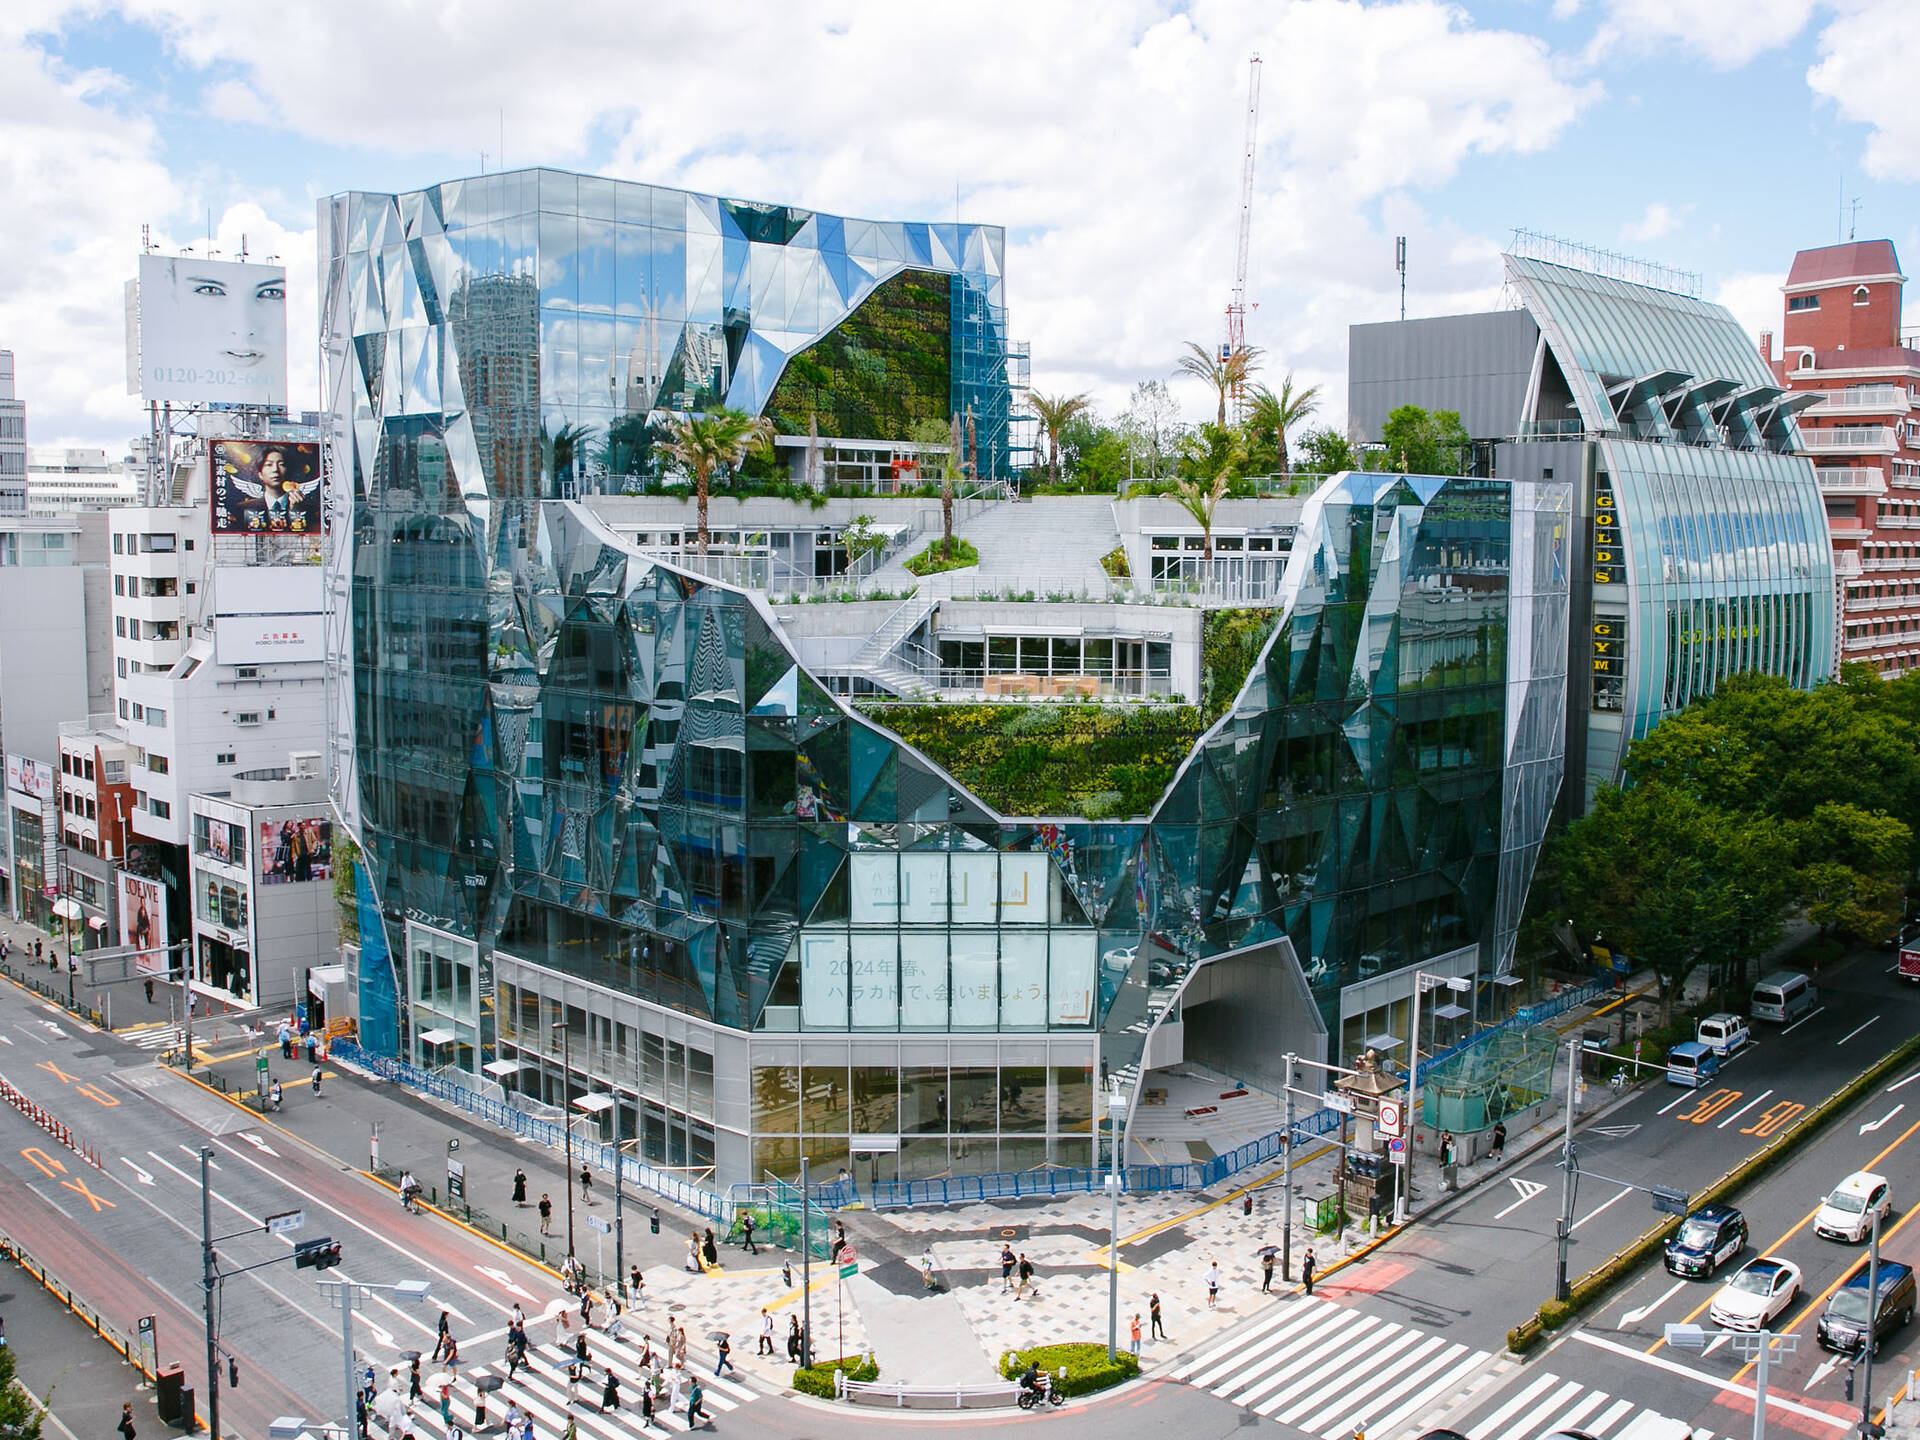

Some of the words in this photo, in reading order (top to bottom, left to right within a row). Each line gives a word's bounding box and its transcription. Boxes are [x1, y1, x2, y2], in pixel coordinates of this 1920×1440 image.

[1594, 624, 1611, 671] GYM
[125, 876, 159, 903] LOEWE
[1676, 1088, 1743, 1124] 50
[1739, 1101, 1805, 1138] 50
